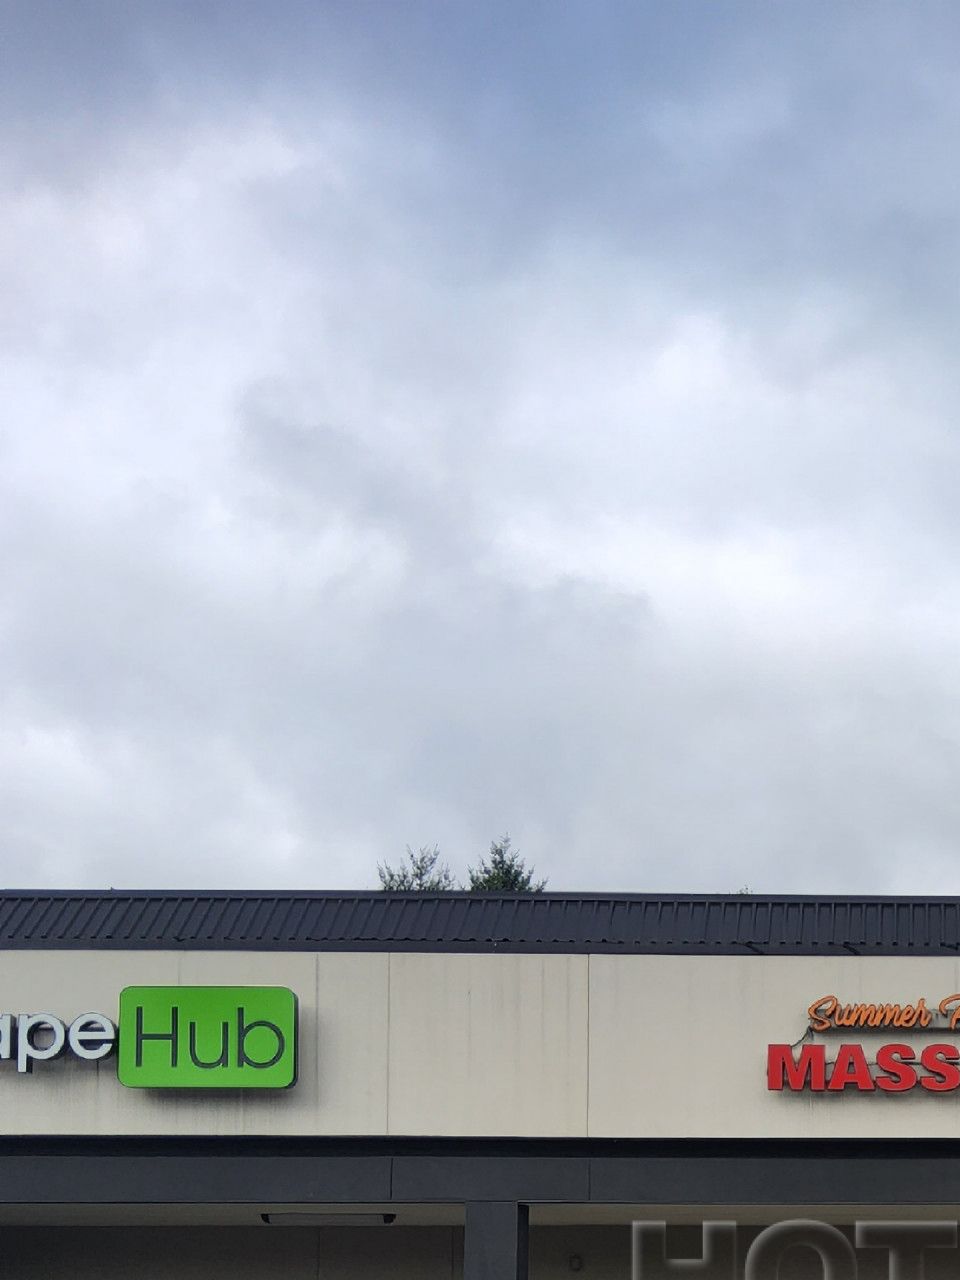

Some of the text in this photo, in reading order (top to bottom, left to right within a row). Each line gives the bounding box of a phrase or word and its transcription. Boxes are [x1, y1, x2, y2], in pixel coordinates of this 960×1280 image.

[808, 994, 931, 1031] Summer
[0, 1006, 285, 1073] pe Hub
